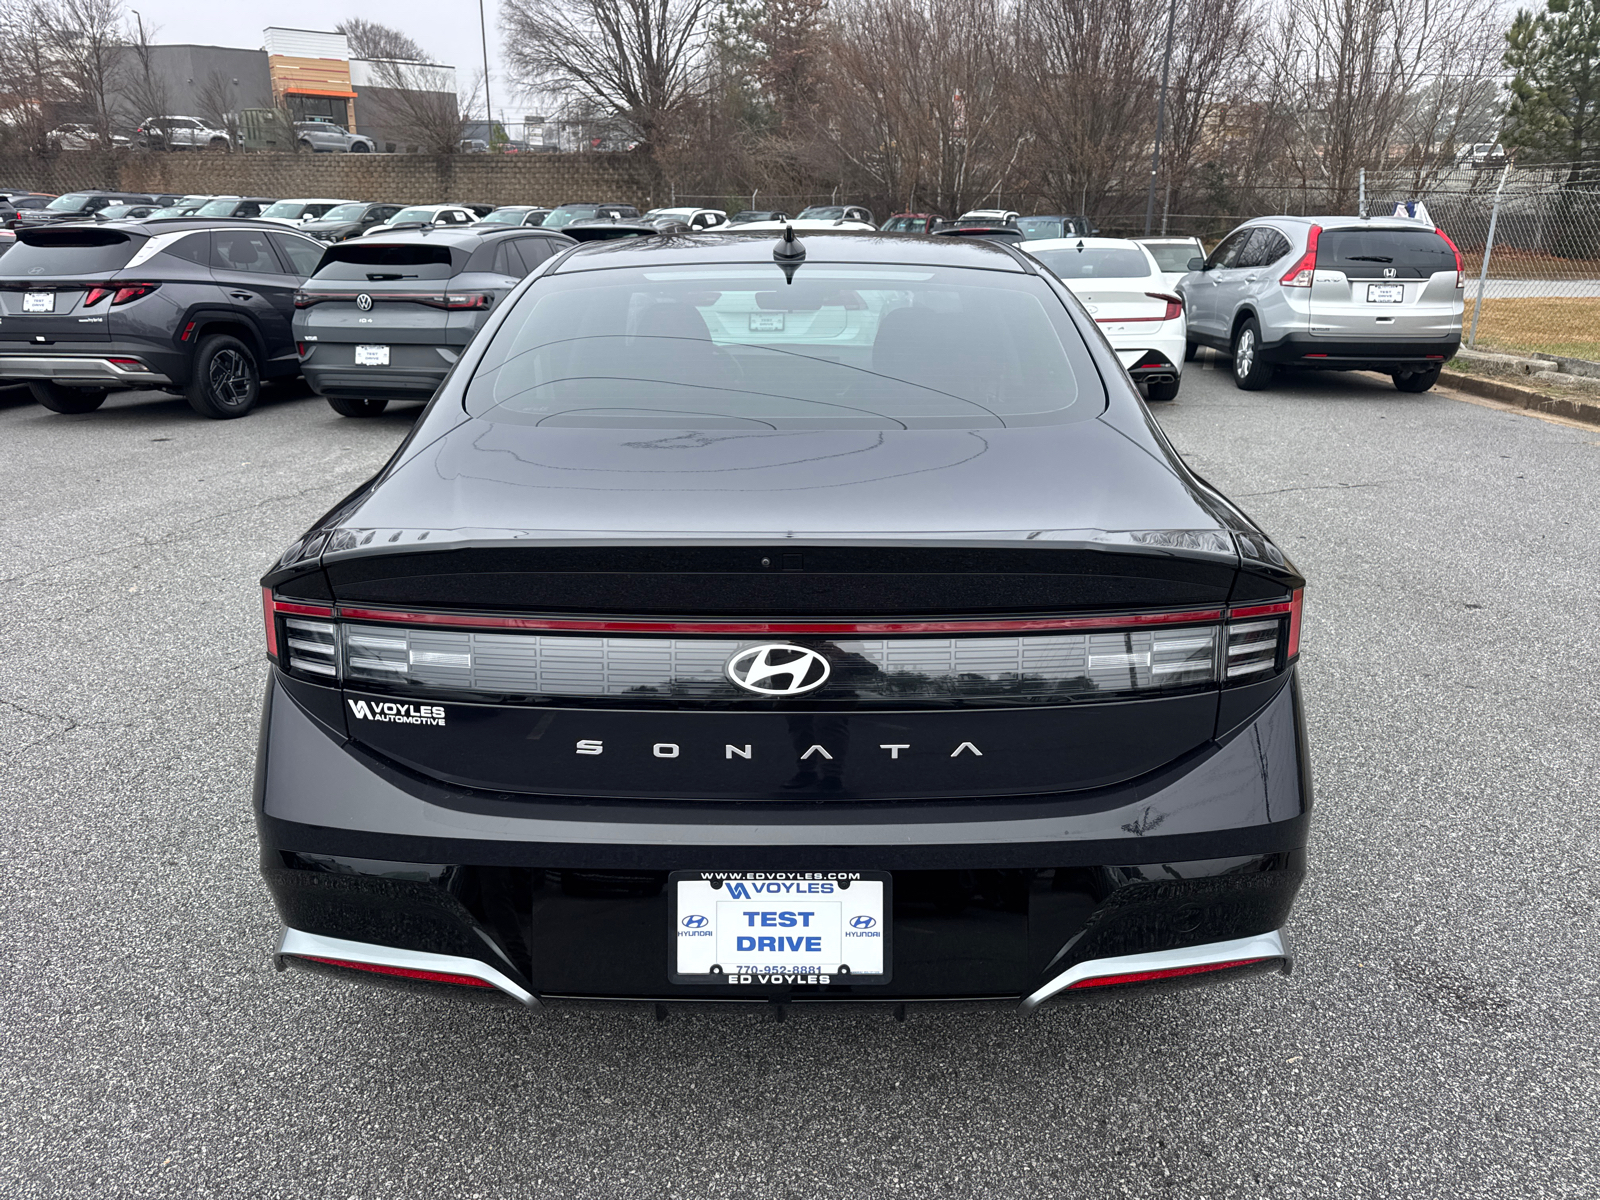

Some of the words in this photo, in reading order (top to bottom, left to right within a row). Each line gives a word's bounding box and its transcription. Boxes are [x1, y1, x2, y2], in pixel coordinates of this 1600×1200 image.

[371, 701, 446, 718] VOYLES
[374, 714, 446, 726] AUTOMOTIVE
[575, 739, 983, 760] SONATA
[700, 872, 861, 880] WWW.EDVOYLES.COM
[751, 882, 835, 894] VOYLES
[742, 911, 815, 928] TEST
[736, 936, 822, 952] DRIVE
[736, 965, 822, 974] 770-952-8881
[728, 975, 752, 984] ED
[758, 975, 831, 984] VOYLES
